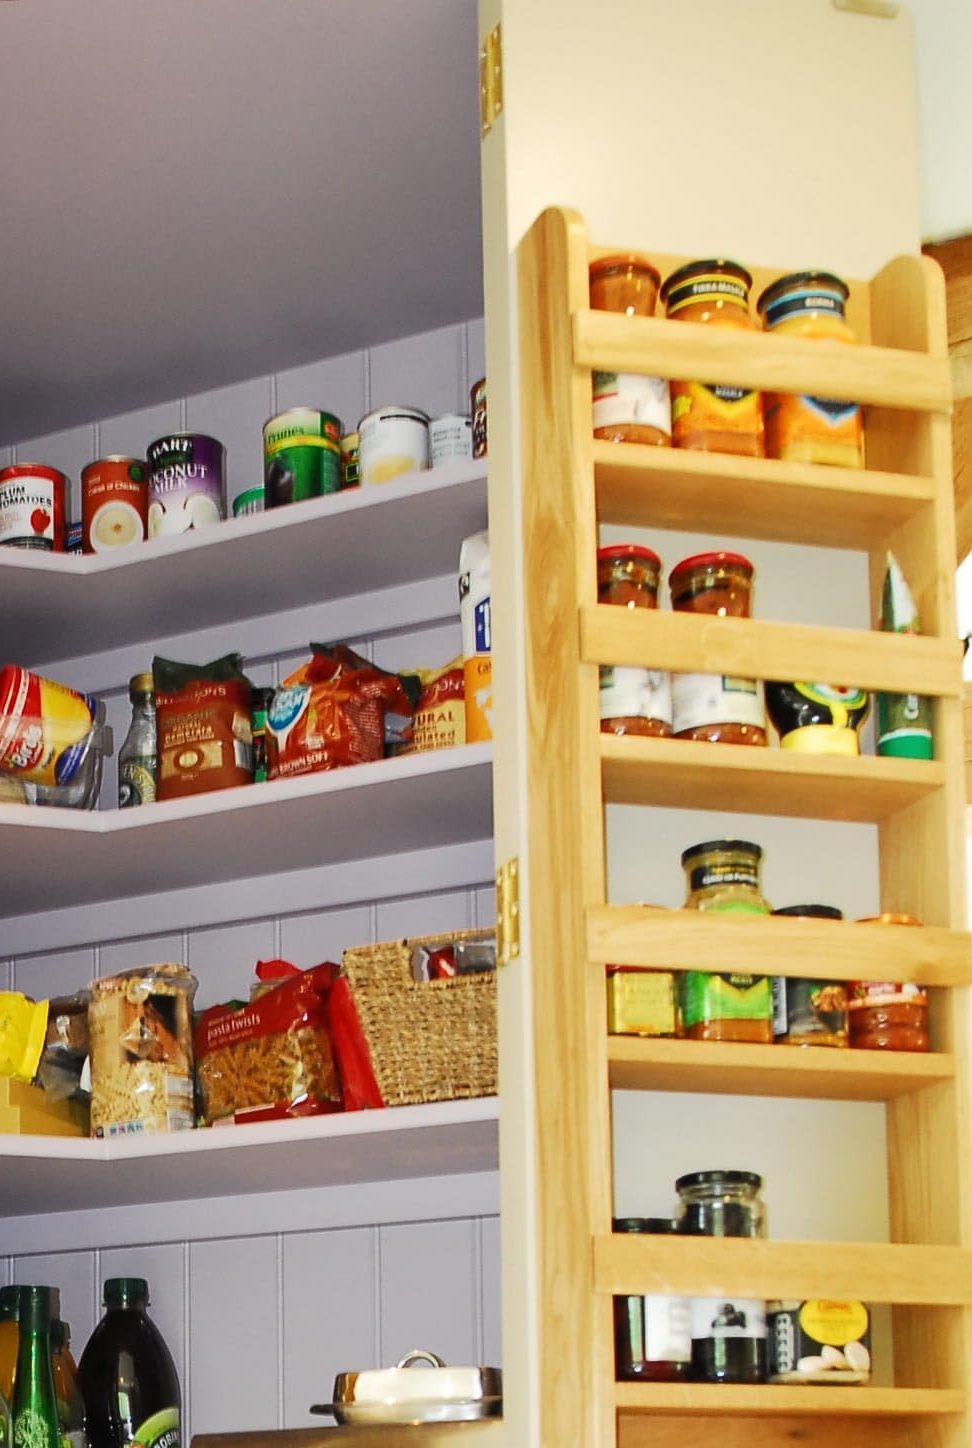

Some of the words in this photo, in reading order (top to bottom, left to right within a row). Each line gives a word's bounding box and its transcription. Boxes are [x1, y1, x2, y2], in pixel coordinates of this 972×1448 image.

[149, 463, 208, 487] OCONUT
[413, 711, 455, 727] URAL
[415, 729, 456, 743] ulated
[207, 1021, 230, 1041] pasta
